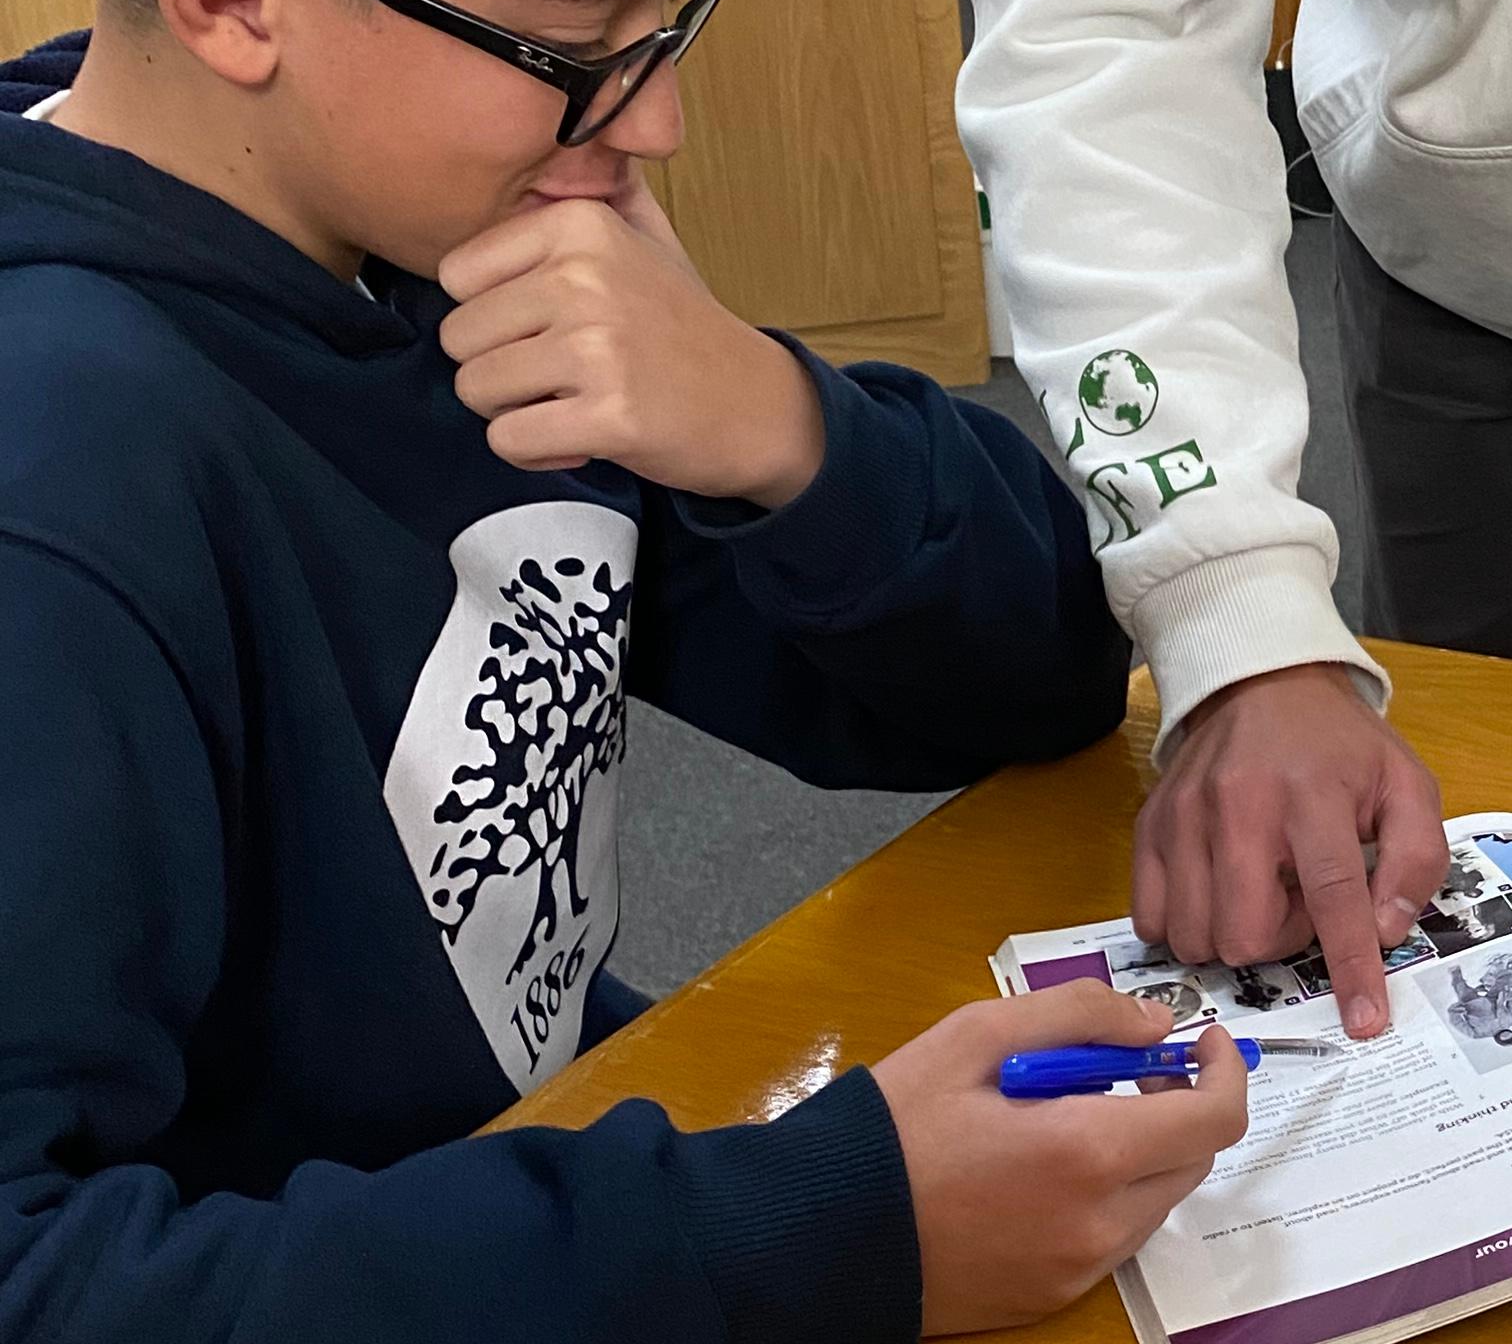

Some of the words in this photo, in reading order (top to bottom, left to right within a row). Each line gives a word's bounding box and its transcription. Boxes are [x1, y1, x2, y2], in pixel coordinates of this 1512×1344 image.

[510, 920, 591, 1075] 1886
[1435, 1099, 1506, 1133] thinking
[1202, 1229, 1226, 1242] radio
